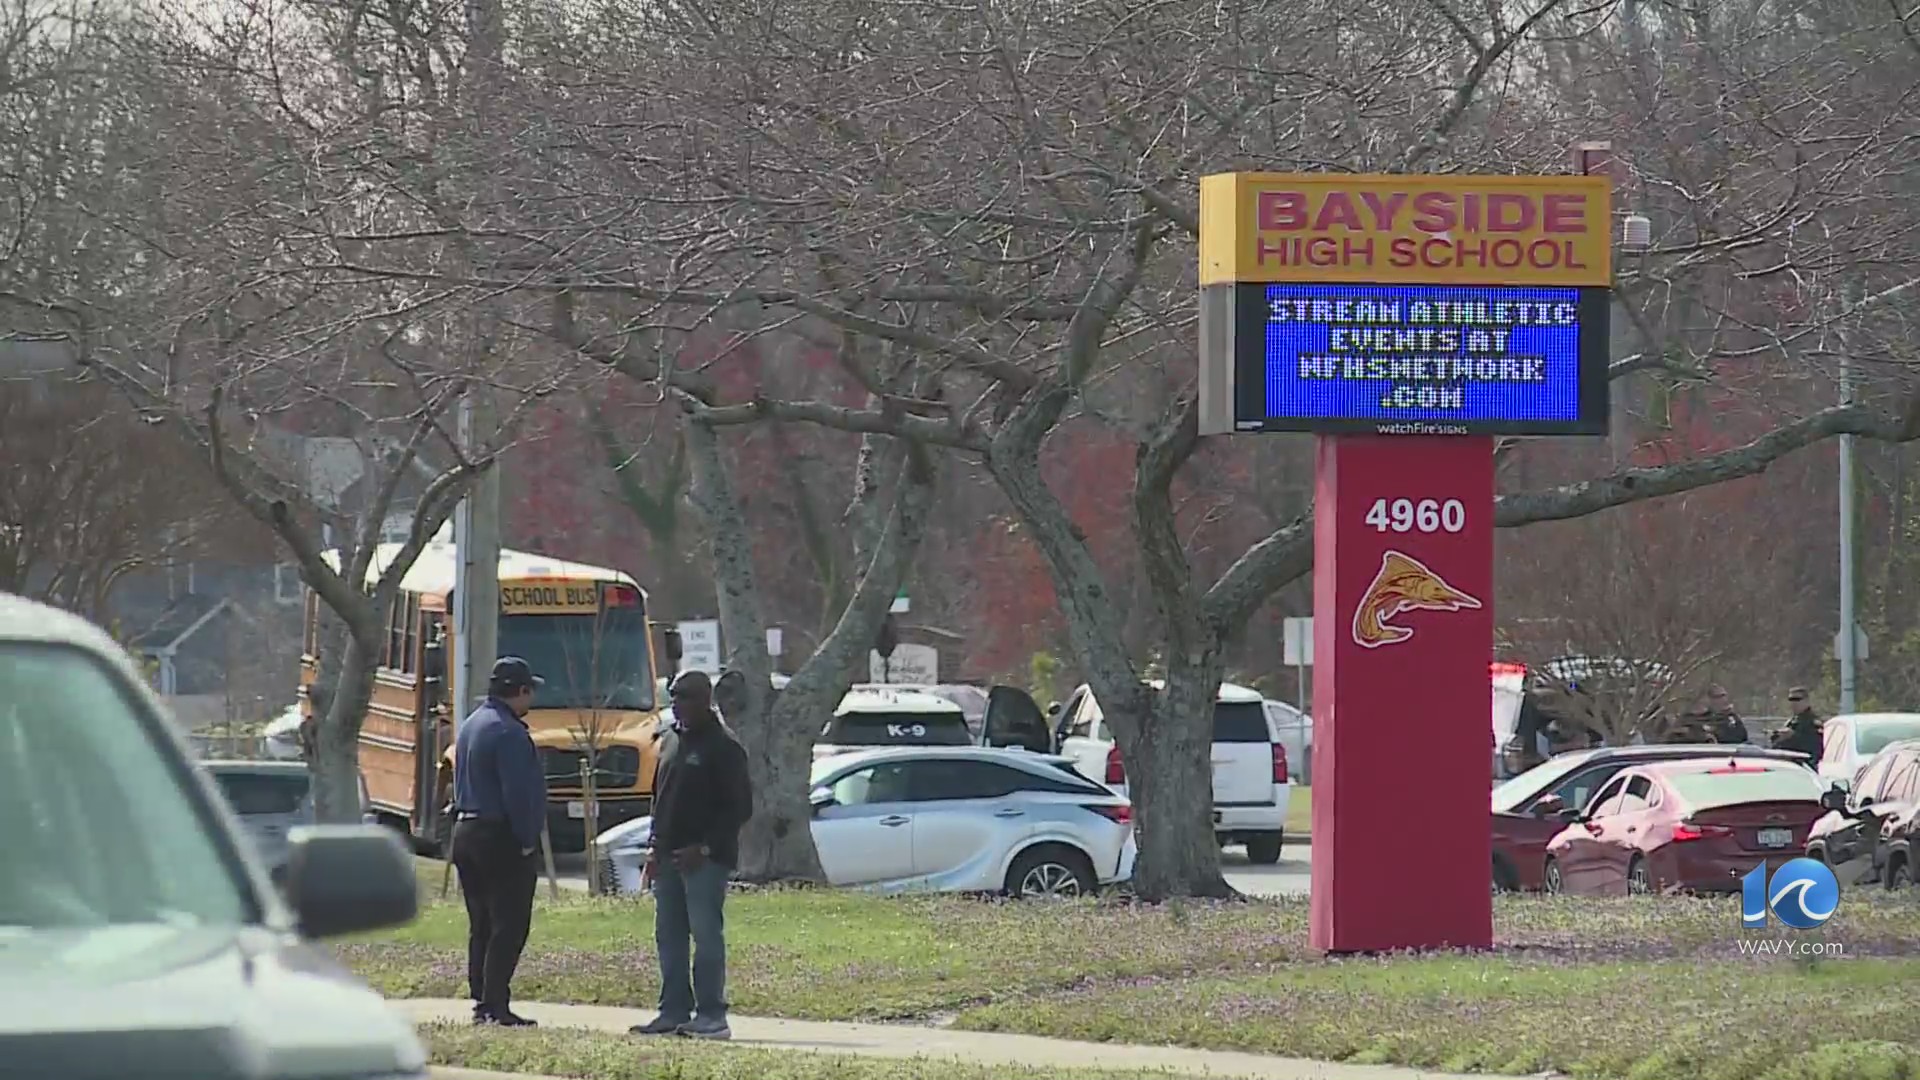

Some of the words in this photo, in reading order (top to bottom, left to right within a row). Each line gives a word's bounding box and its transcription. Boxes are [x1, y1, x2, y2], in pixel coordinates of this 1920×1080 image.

[1257, 192, 1588, 234] BAYSIDE
[1257, 236, 1374, 267] HIGH
[1388, 237, 1588, 269] SCHOOL
[1268, 299, 1404, 324] STREAM
[1408, 299, 1577, 325] ATHLETIC
[1329, 327, 1459, 352] EVENTS
[1466, 328, 1511, 352] AT
[1299, 355, 1545, 380] NFHSNETWORK
[1381, 385, 1463, 408] .COM
[1365, 498, 1465, 533] 4960
[503, 587, 564, 606] SCHOOL
[566, 587, 596, 605] BUS
[886, 723, 926, 738] K-9
